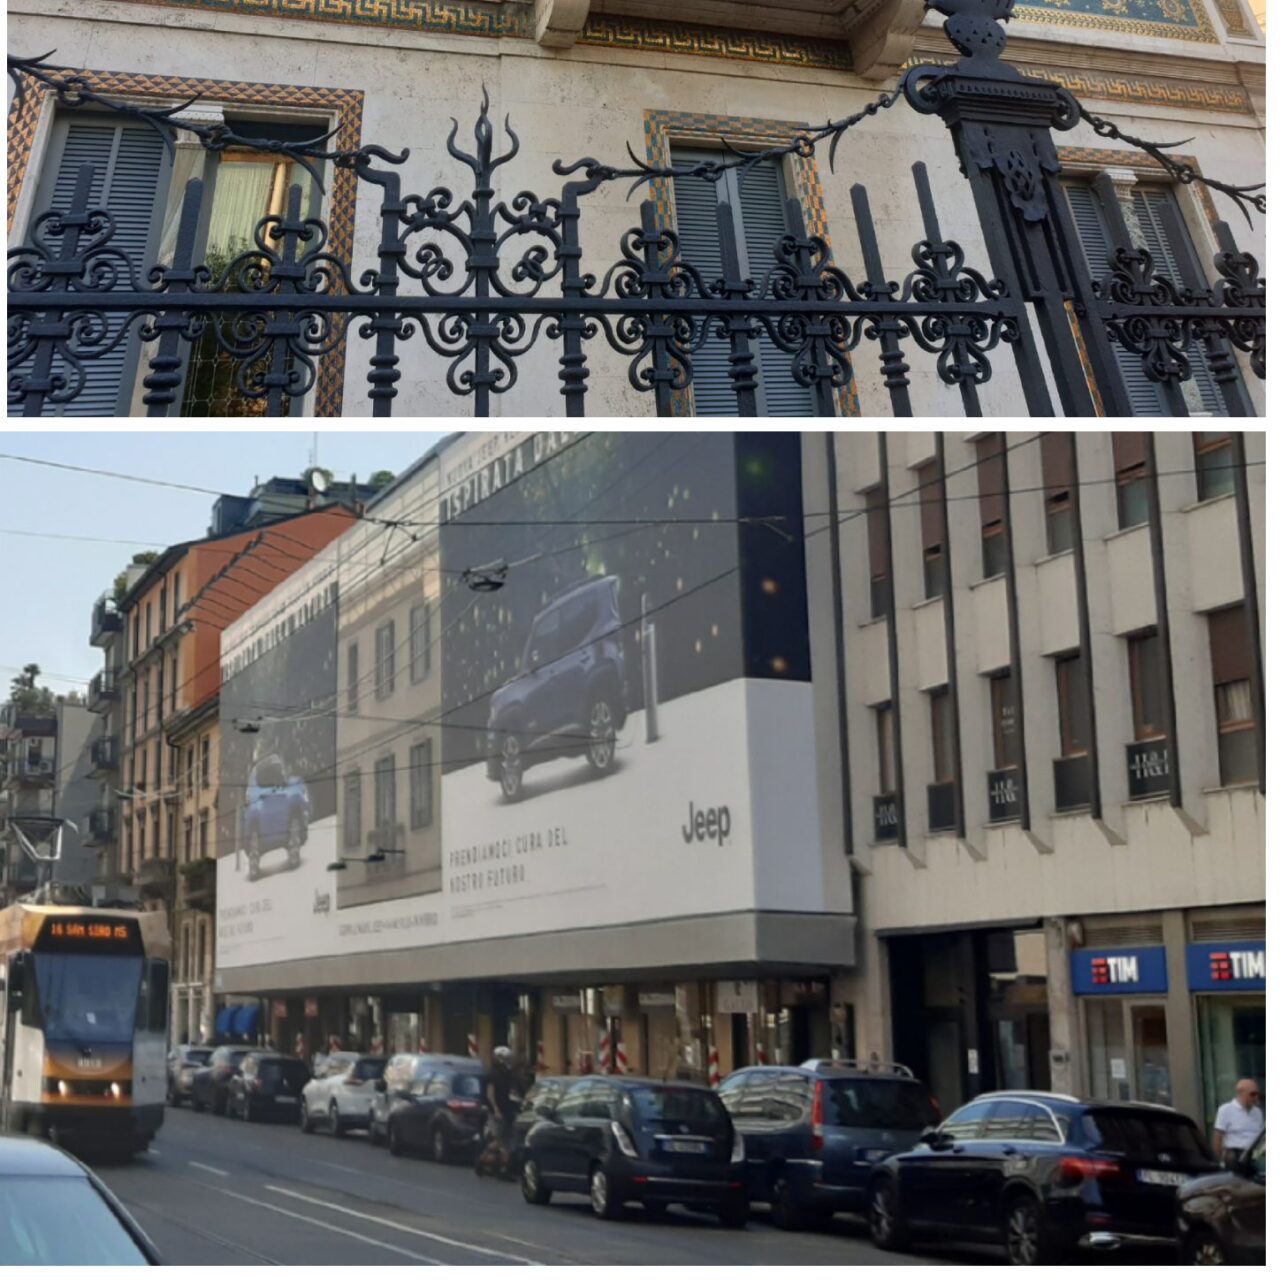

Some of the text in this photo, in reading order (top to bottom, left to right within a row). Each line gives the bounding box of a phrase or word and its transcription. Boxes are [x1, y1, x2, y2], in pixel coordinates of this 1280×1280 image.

[446, 446, 524, 521] ISPIRATA
[682, 800, 731, 847] Jeep
[516, 831, 543, 855] CURA
[548, 826, 568, 848] DEL
[449, 863, 525, 894] NOSTRO FUTURO
[1107, 956, 1139, 983] TIM
[1230, 951, 1266, 979] TIM
